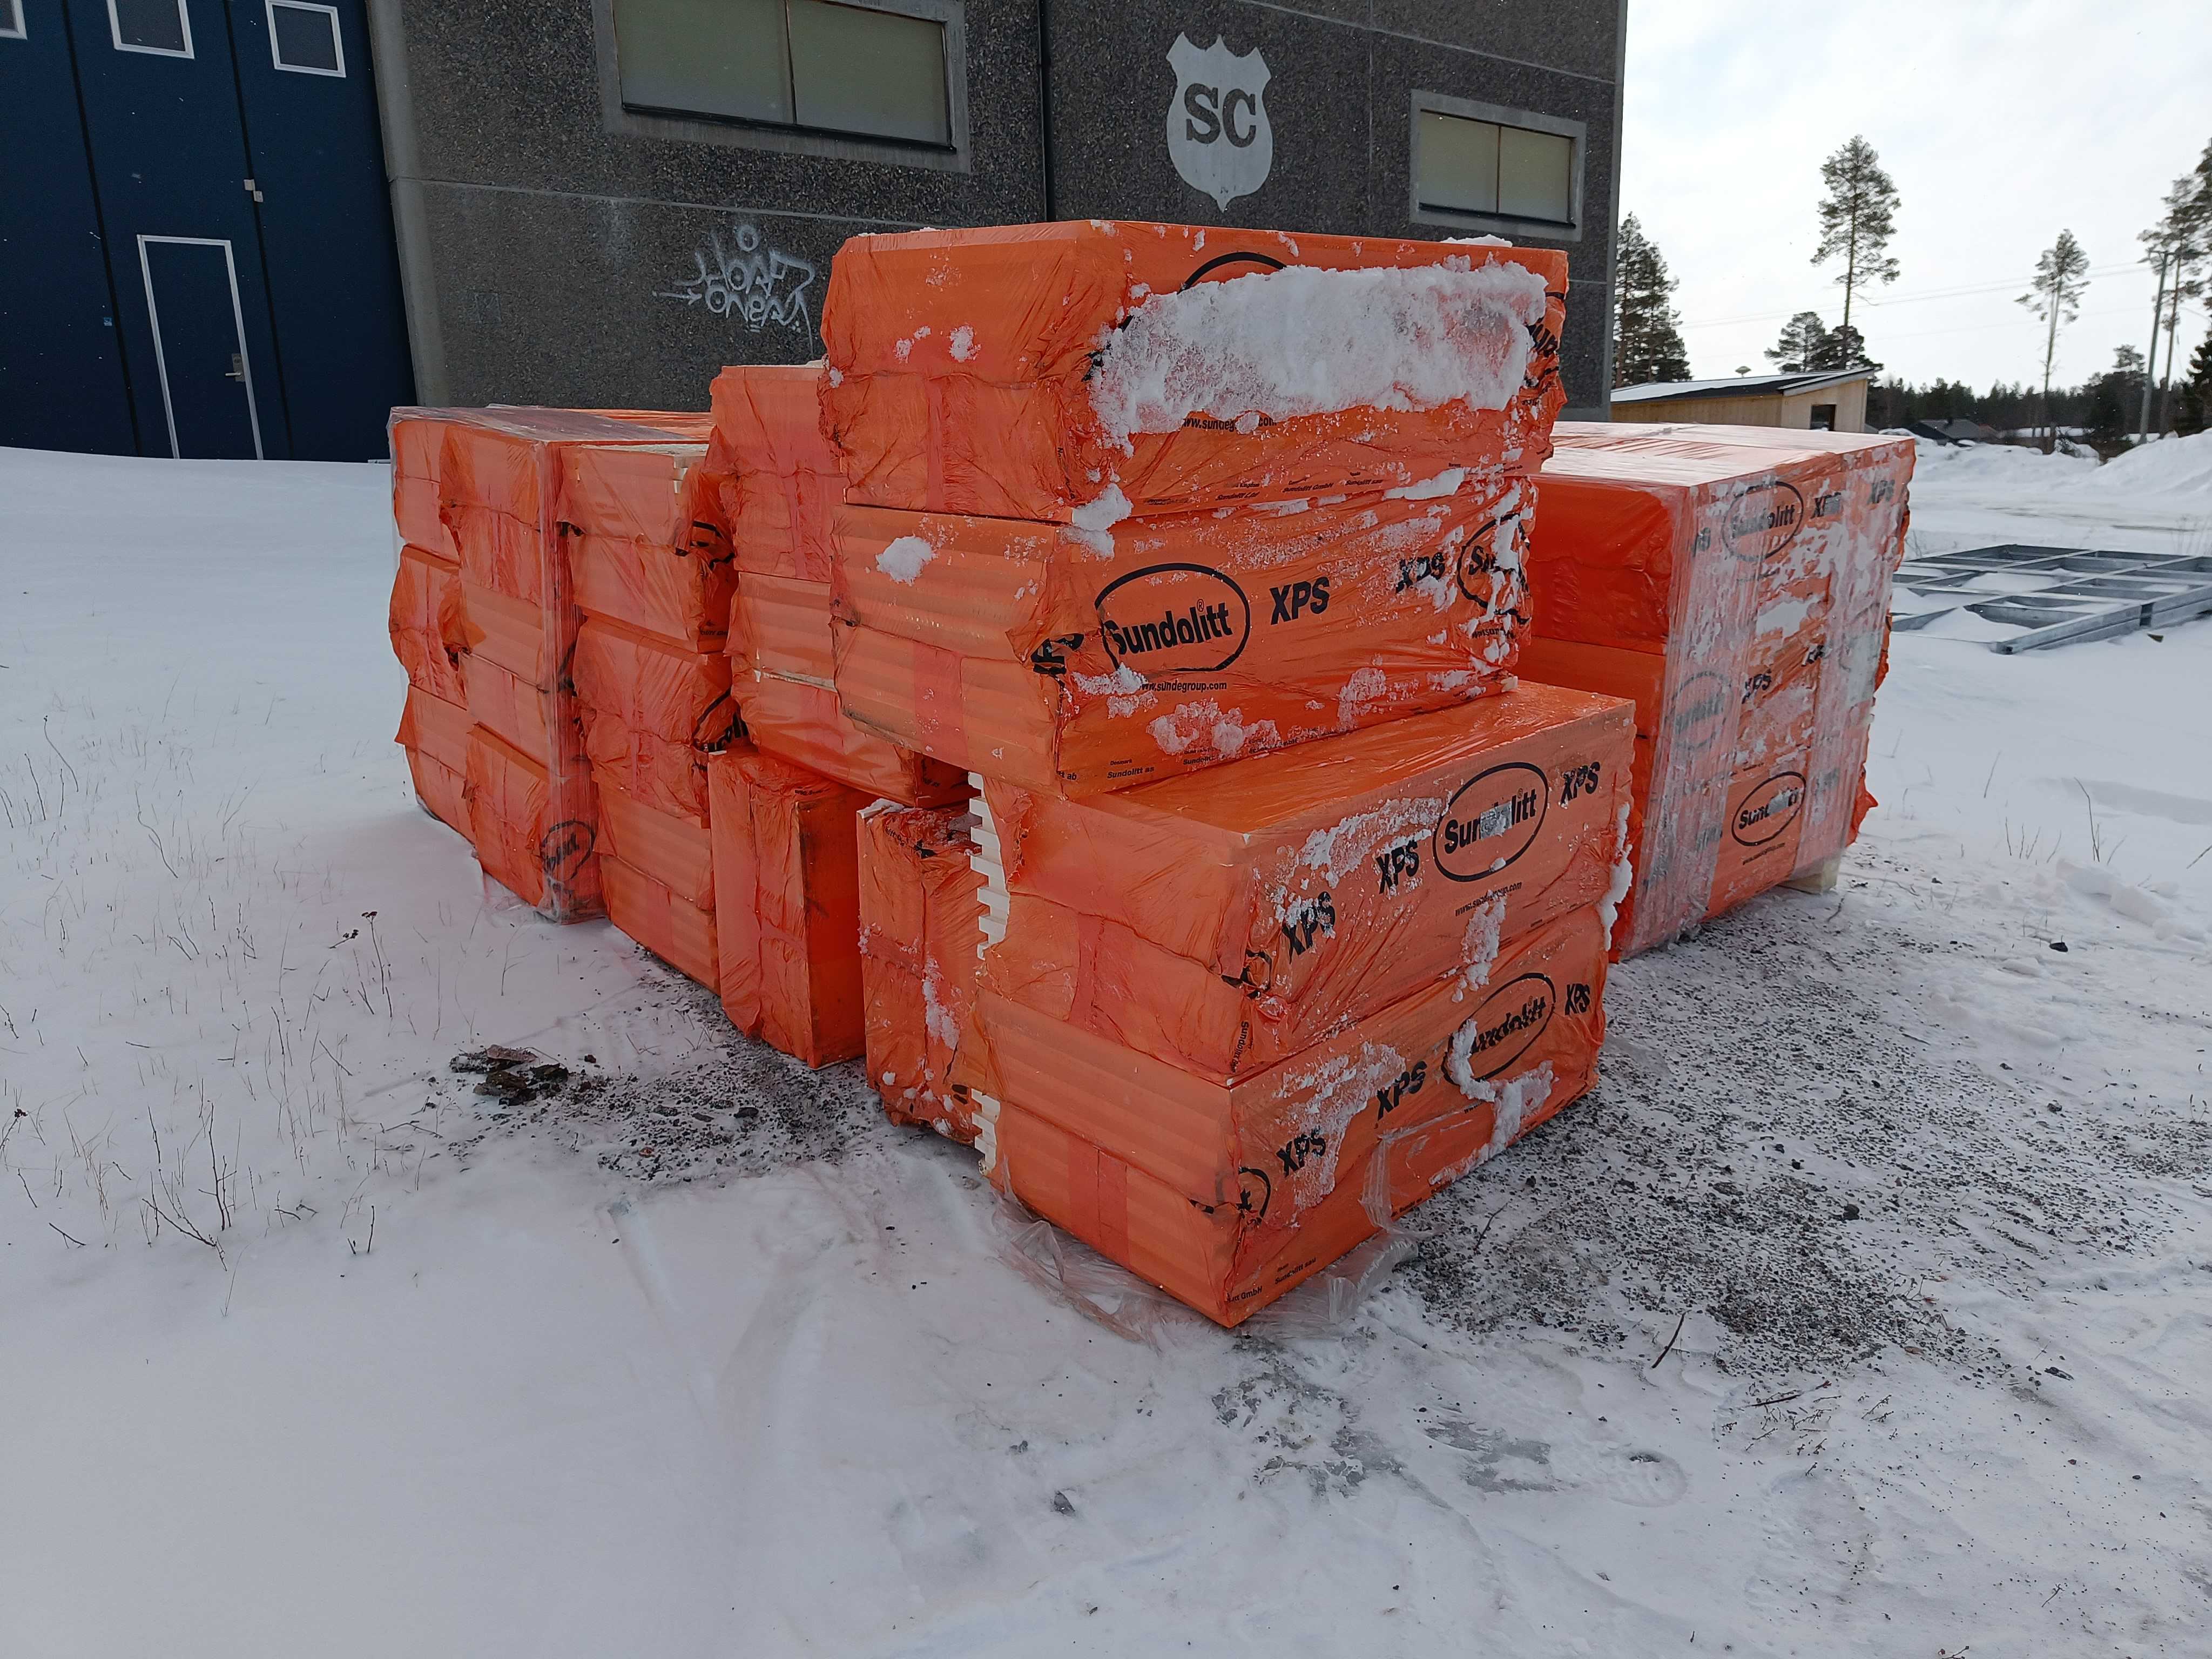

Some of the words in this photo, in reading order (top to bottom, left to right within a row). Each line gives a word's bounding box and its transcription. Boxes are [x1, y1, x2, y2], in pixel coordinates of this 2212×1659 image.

[1184, 83, 1256, 148] SC
[1270, 577, 1330, 625] XPS
[1103, 602, 1233, 655] Sundolitt
[1067, 772, 1077, 780] ab
[1107, 767, 1143, 779] Sundolitt
[1561, 761, 1601, 804] XPS
[1444, 788, 1537, 854] Sunlitt
[1375, 839, 1419, 894] XPS
[1471, 996, 1549, 1055] undolitt
[1564, 983, 1590, 1016] XPS
[1377, 1061, 1428, 1121] XPS
[1276, 1125, 1326, 1178] XPS
[1242, 1286, 1263, 1300] GmbH
